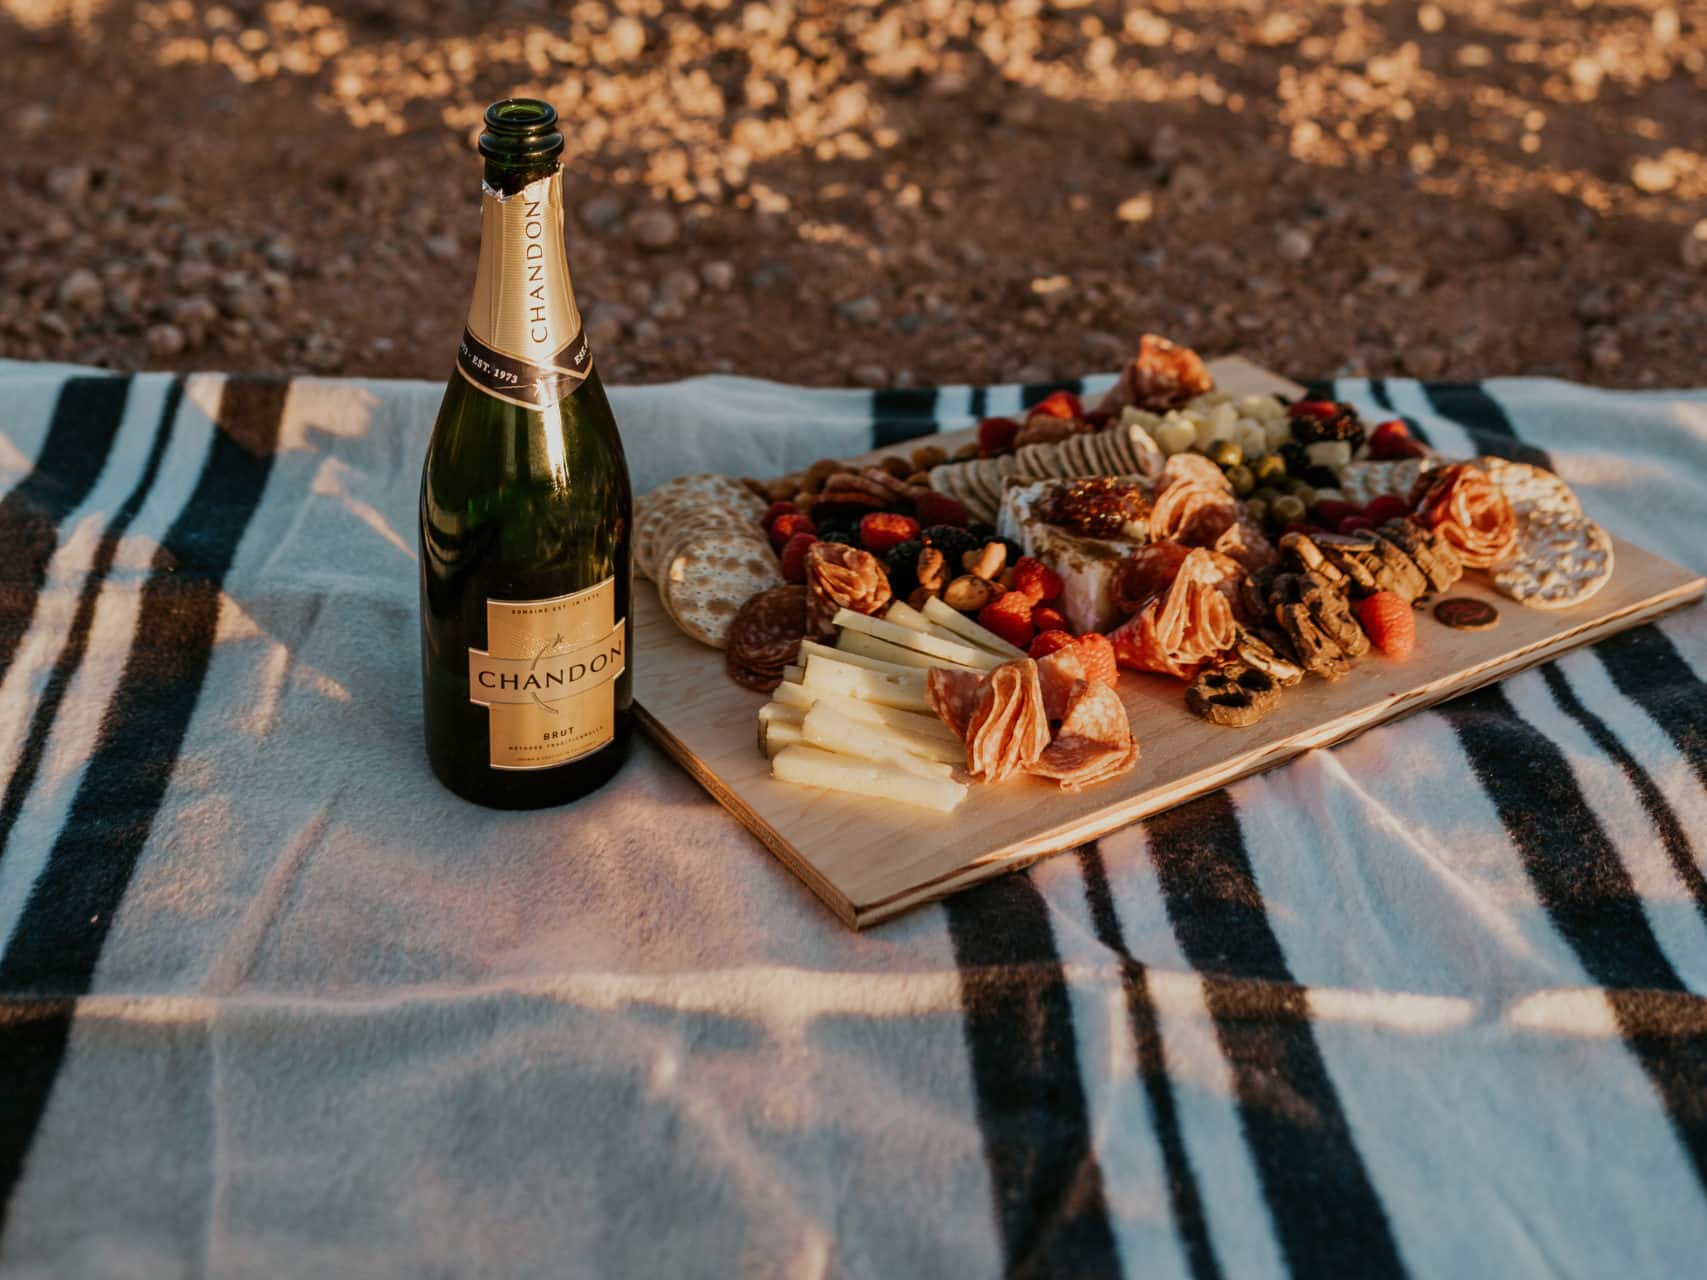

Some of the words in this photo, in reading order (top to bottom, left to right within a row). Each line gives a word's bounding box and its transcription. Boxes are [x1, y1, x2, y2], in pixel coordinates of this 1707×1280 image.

[525, 201, 548, 343] CHANDON
[472, 355, 491, 374] EST.
[493, 368, 518, 384] 1973
[478, 640, 622, 690] CHANDON
[543, 726, 575, 741] BRUT
